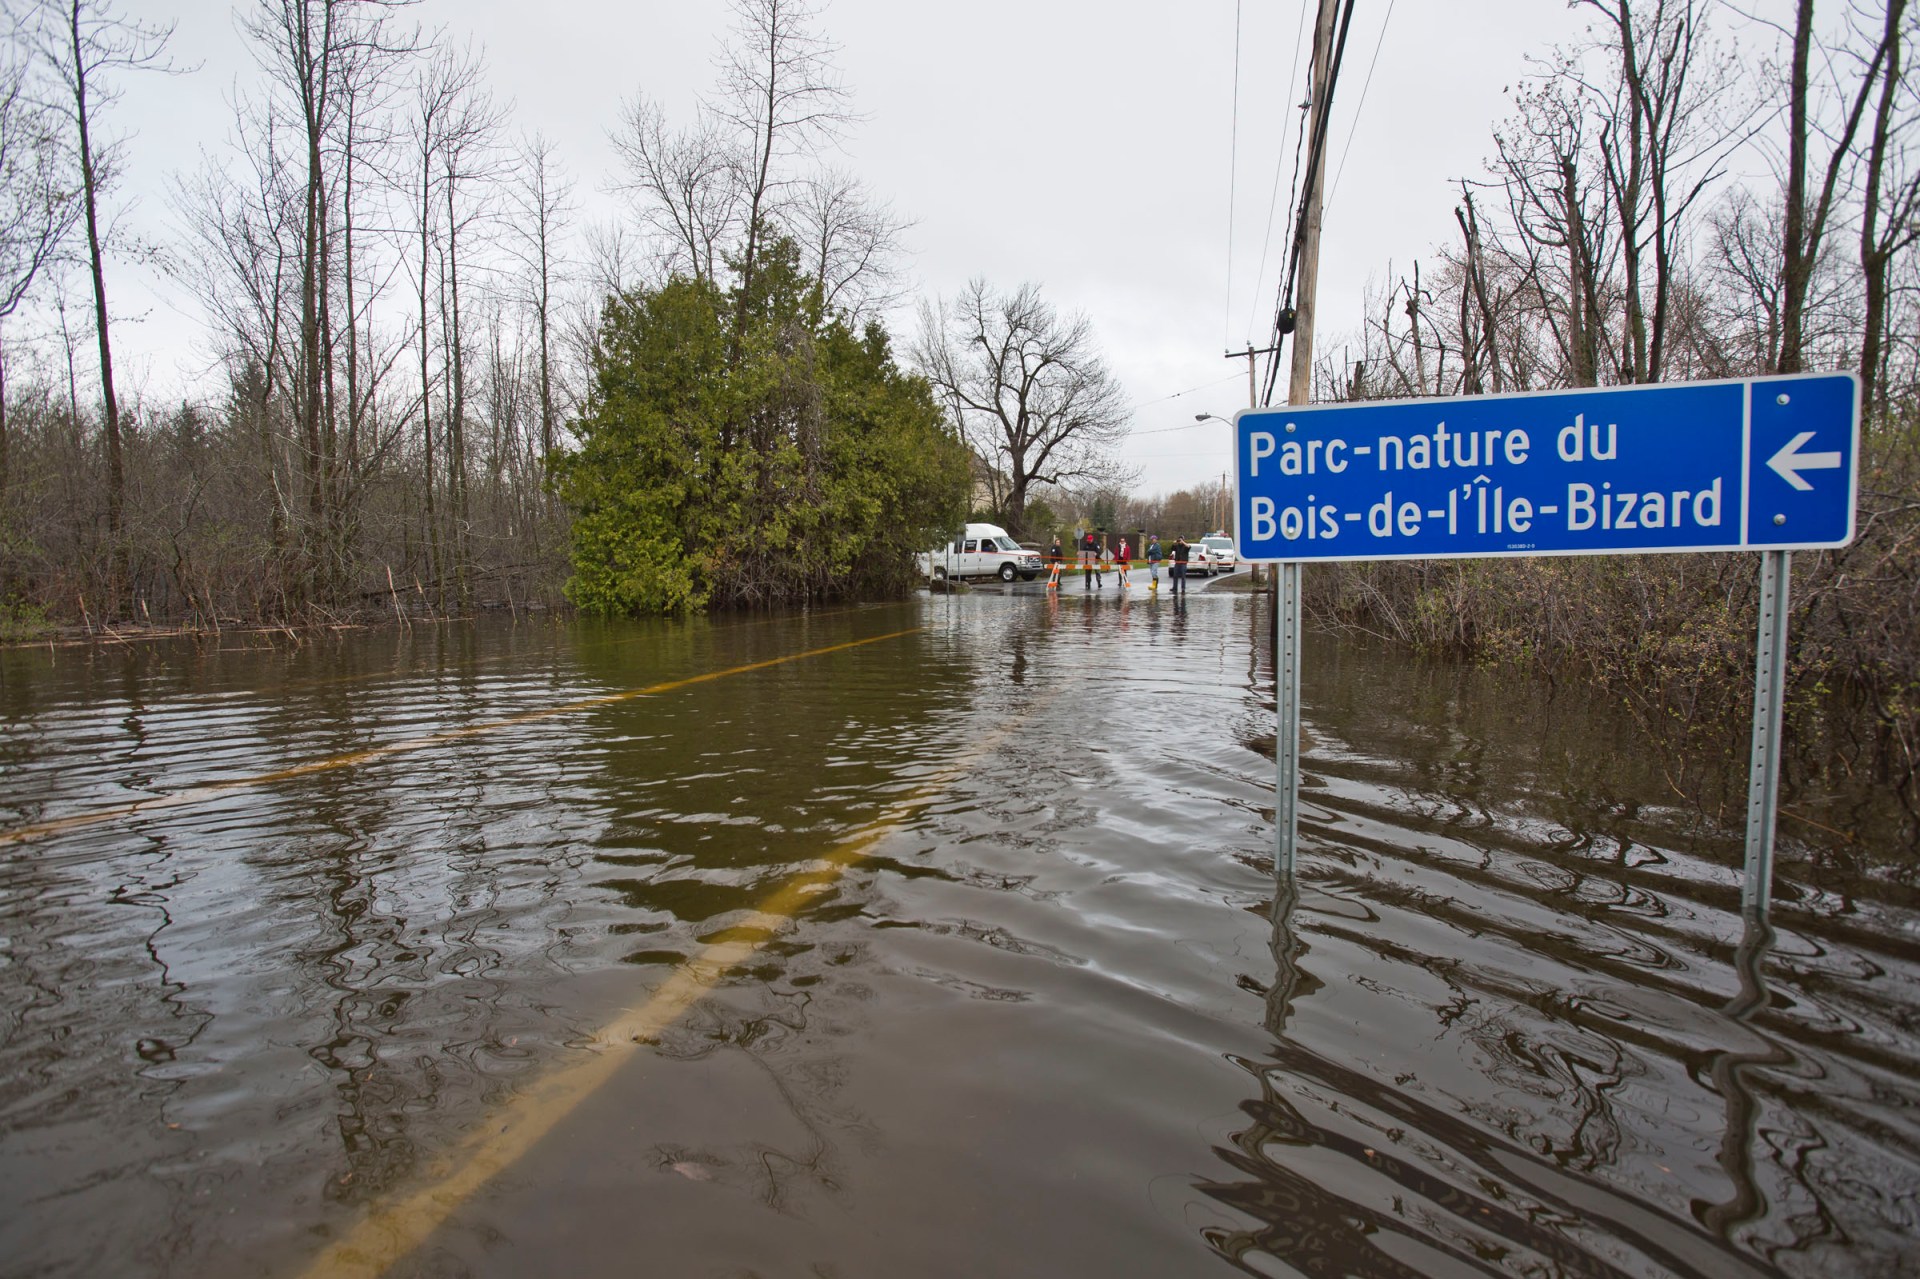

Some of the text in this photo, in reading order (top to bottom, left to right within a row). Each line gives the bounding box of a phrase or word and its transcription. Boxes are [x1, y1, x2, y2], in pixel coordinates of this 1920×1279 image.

[1250, 413, 1617, 477] Parc-nature du
[1251, 475, 1722, 541] Bois-de-l'Île-Bizard
